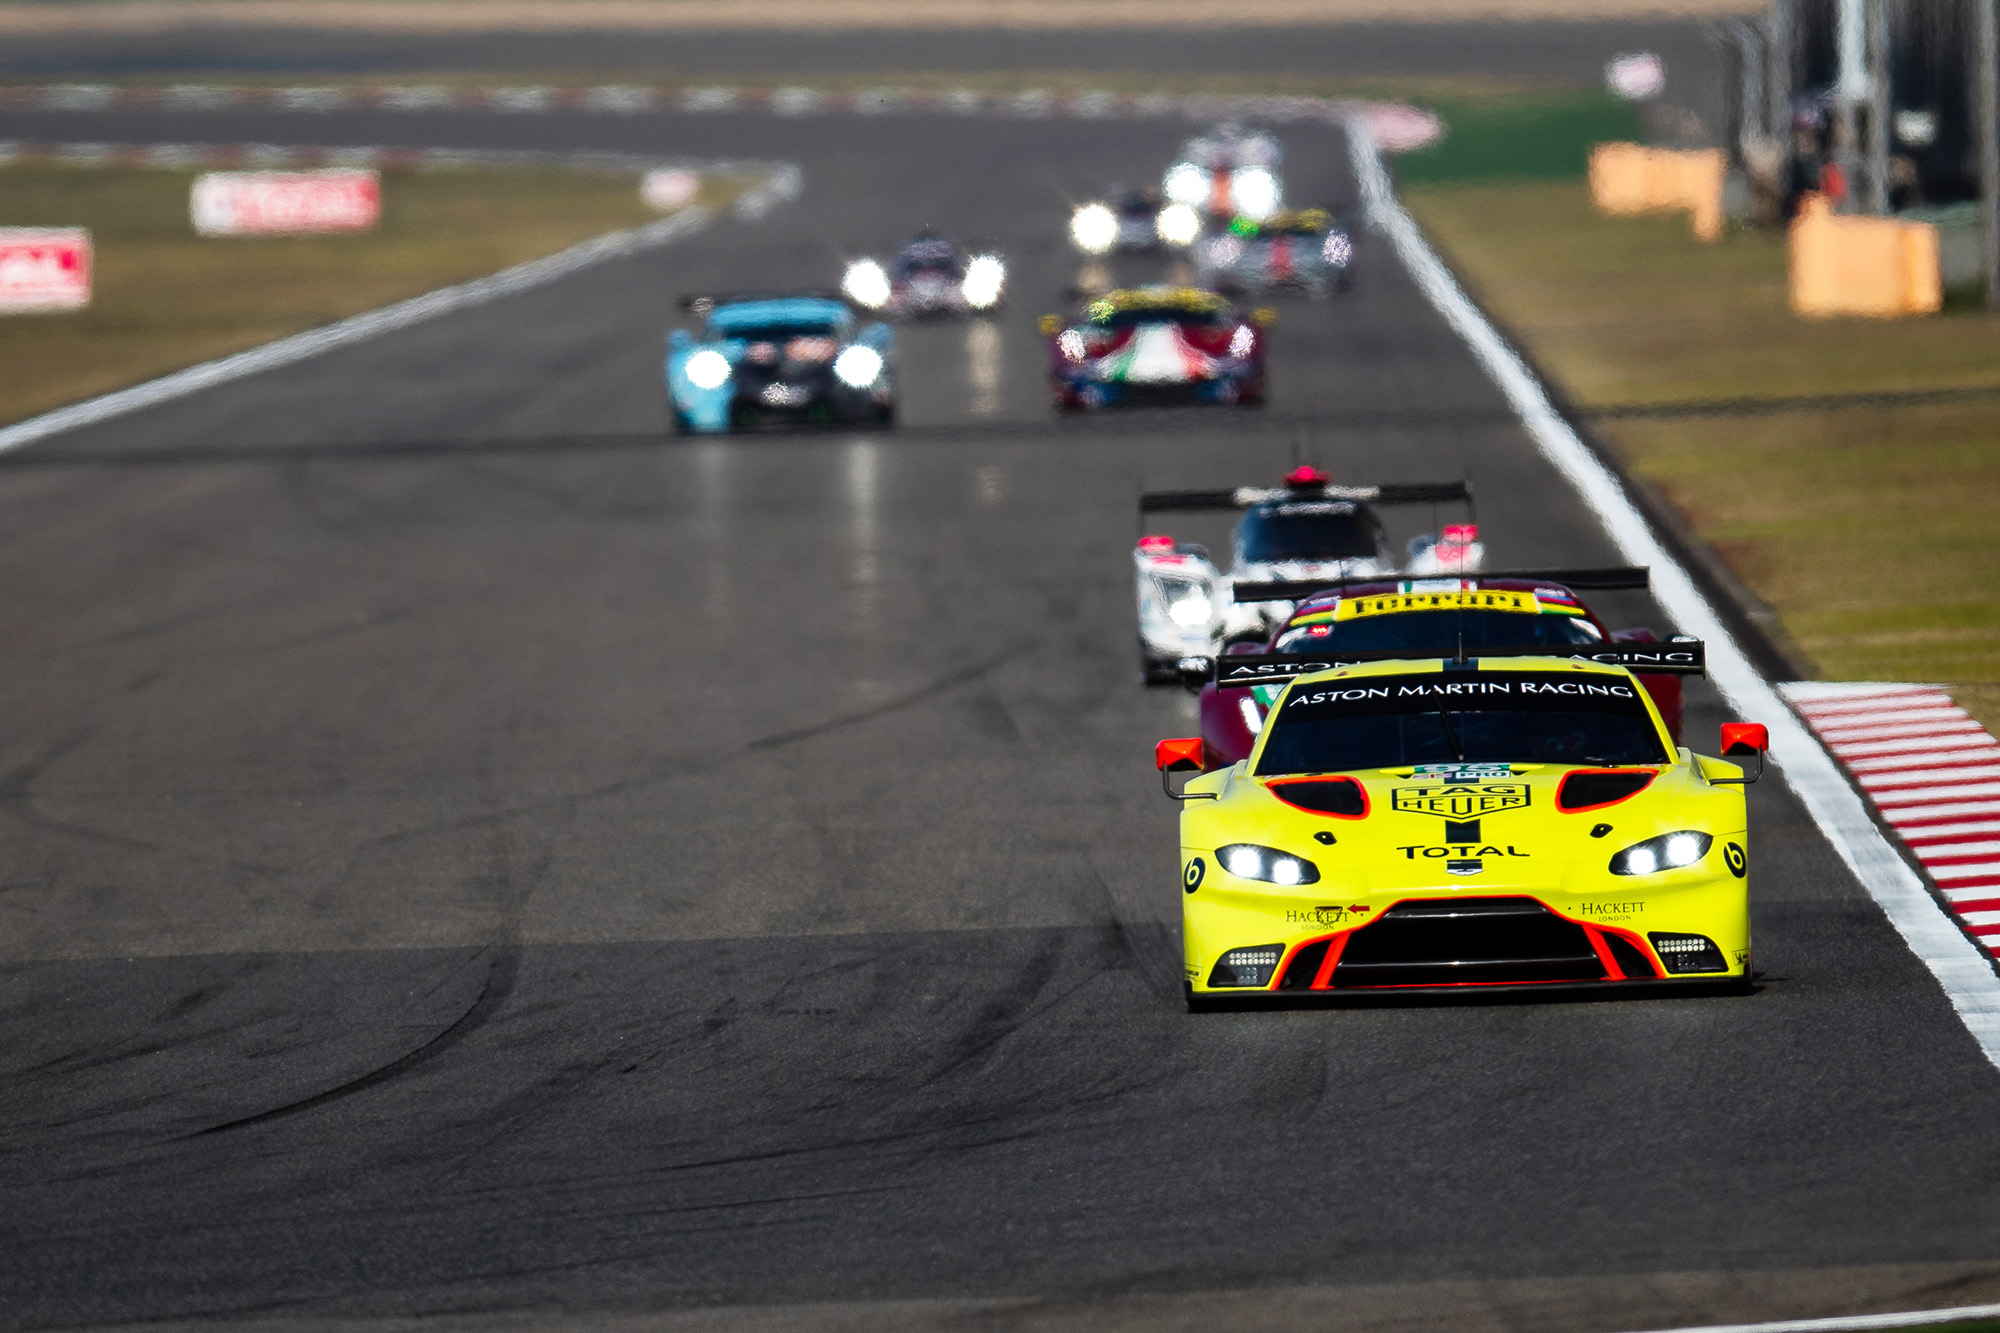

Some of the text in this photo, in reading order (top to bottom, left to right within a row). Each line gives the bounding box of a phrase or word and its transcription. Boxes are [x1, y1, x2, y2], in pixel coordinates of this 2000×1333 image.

[1355, 591, 1522, 613] Ferrari
[1548, 652, 1694, 661] ACING
[1289, 682, 1634, 707] ASTON MARTIN RACING
[1404, 785, 1516, 796] TAG
[1403, 797, 1520, 815] HEUER
[1396, 845, 1530, 859] TOTAL
[1581, 902, 1645, 915] HACKETT
[1286, 910, 1350, 922] HACKETT
